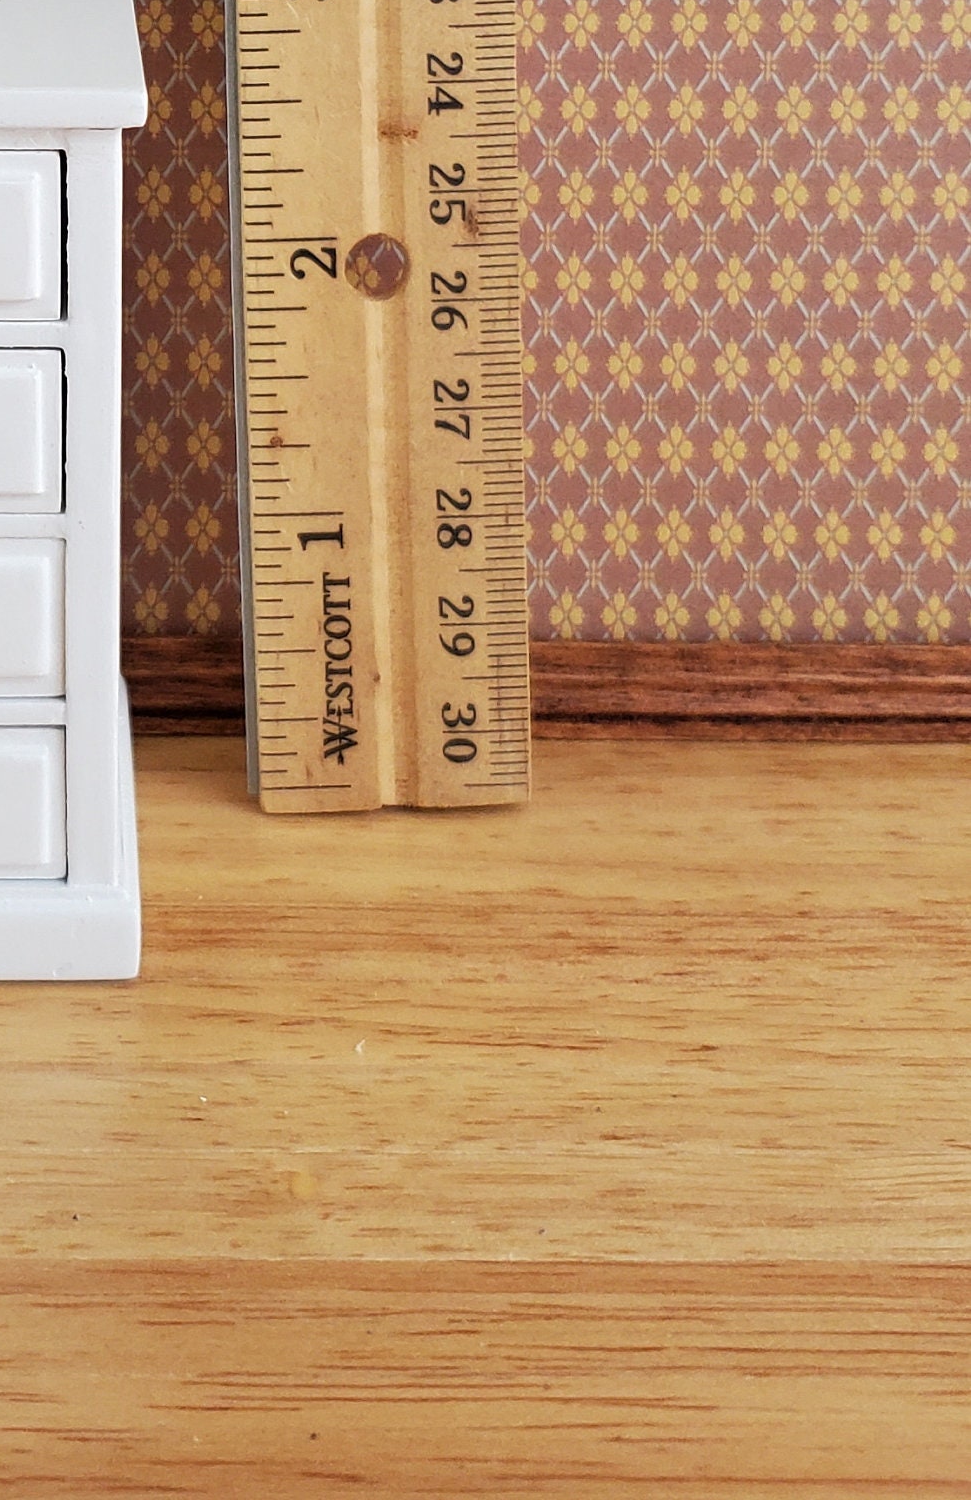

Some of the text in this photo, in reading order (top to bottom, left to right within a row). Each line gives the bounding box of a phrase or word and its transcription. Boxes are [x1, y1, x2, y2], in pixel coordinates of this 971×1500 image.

[427, 52, 464, 116] 24
[429, 163, 466, 225] 25
[289, 246, 337, 280] 2
[430, 270, 468, 331] 26
[433, 379, 471, 440] 27
[296, 523, 344, 551] 1
[436, 488, 473, 550] 28
[438, 595, 475, 657] 29
[322, 571, 358, 760] WESTCOTT
[441, 702, 478, 764] 30
